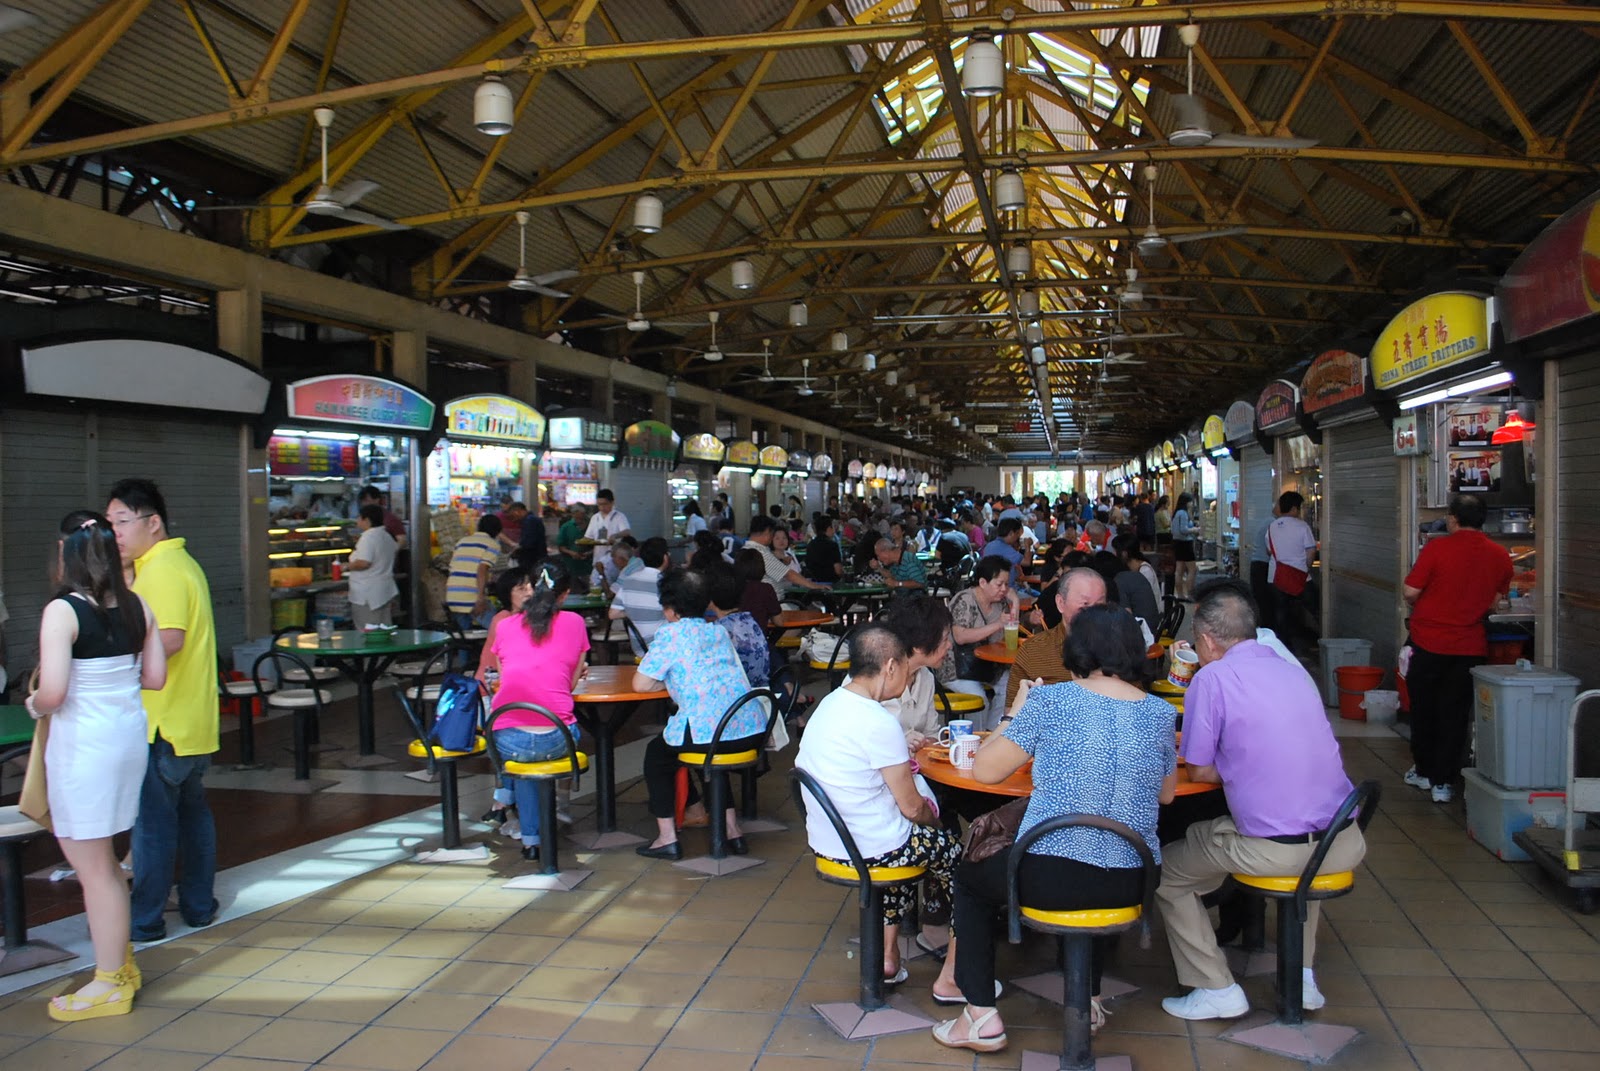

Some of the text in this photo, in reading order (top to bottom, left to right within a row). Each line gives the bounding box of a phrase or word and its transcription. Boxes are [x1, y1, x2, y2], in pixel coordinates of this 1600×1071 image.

[1381, 367, 1400, 382] CHINA
[1401, 355, 1429, 375] STREET
[1431, 336, 1477, 363] FRITTERS
[315, 402, 369, 419] HAINANESE
[1397, 423, 1415, 449] 64
